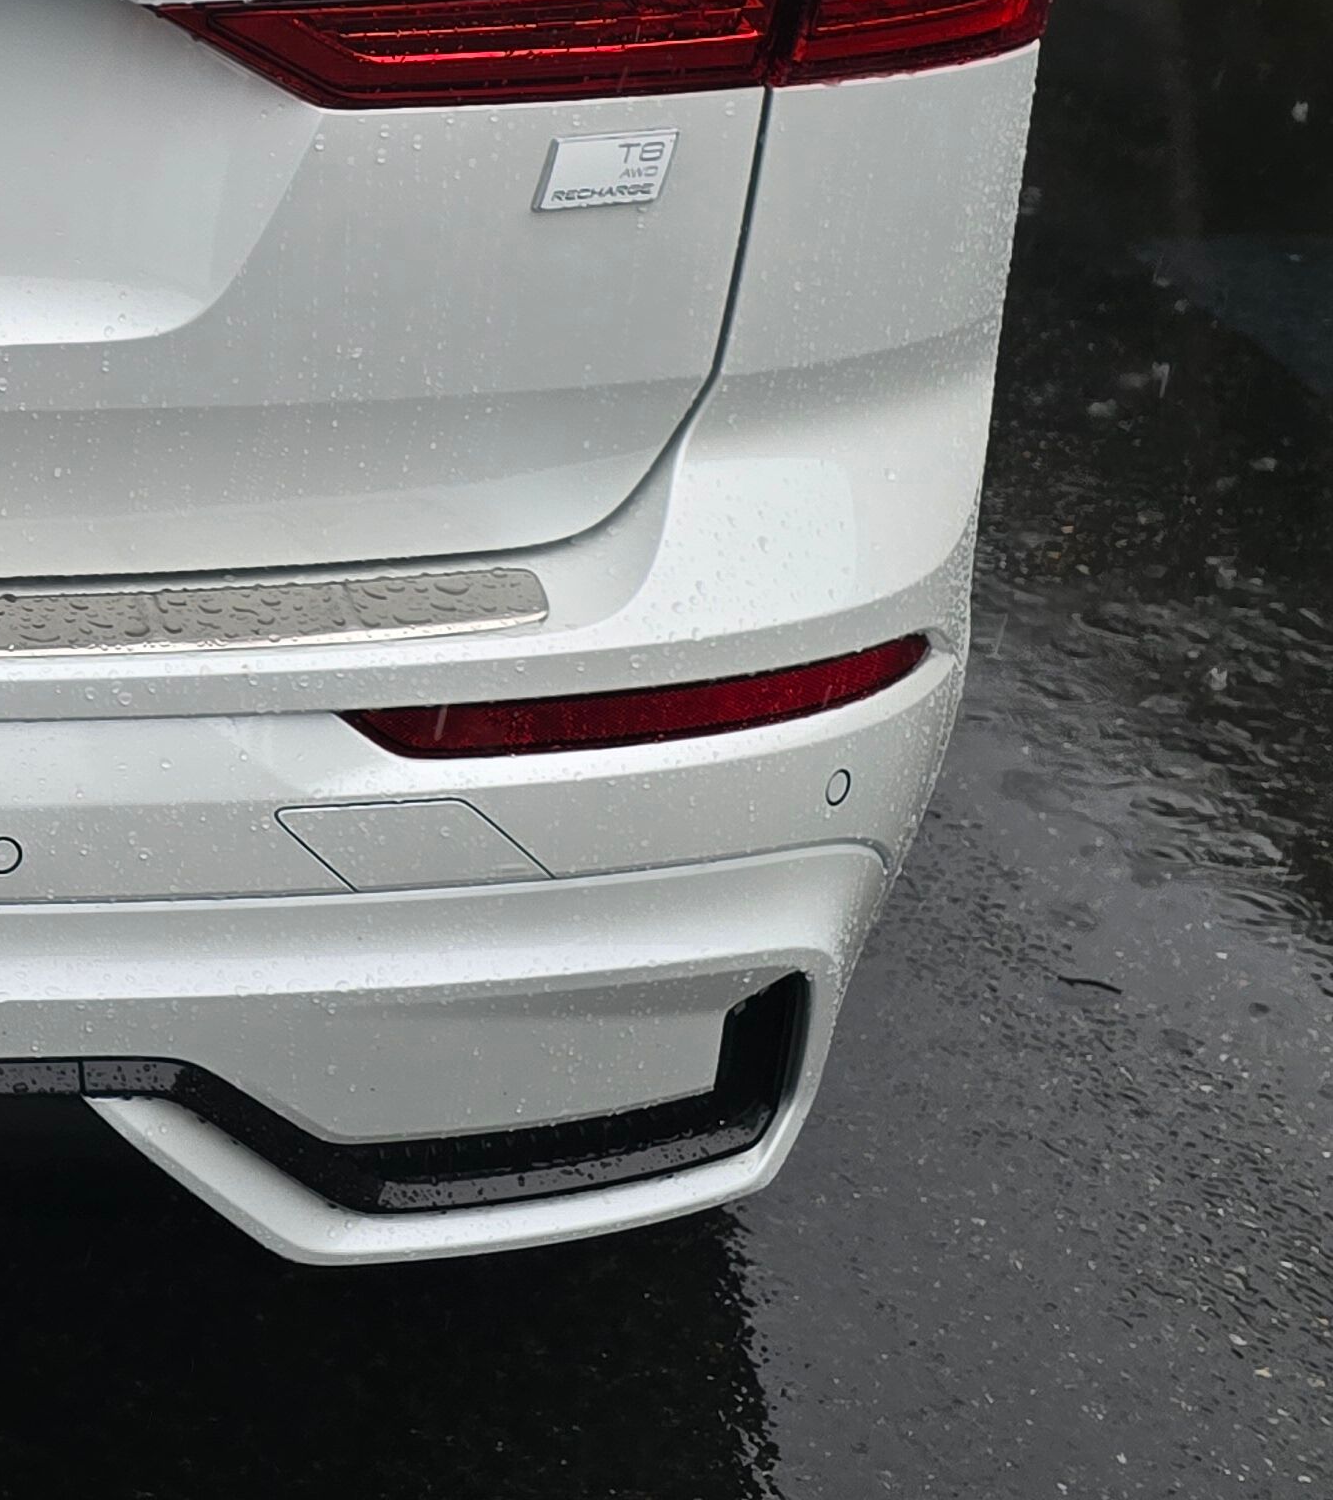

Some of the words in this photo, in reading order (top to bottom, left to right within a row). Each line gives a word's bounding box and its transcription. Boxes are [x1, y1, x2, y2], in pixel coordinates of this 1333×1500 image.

[618, 141, 666, 164] T8
[619, 166, 659, 179] AWD
[550, 183, 655, 202] RECHARGE
